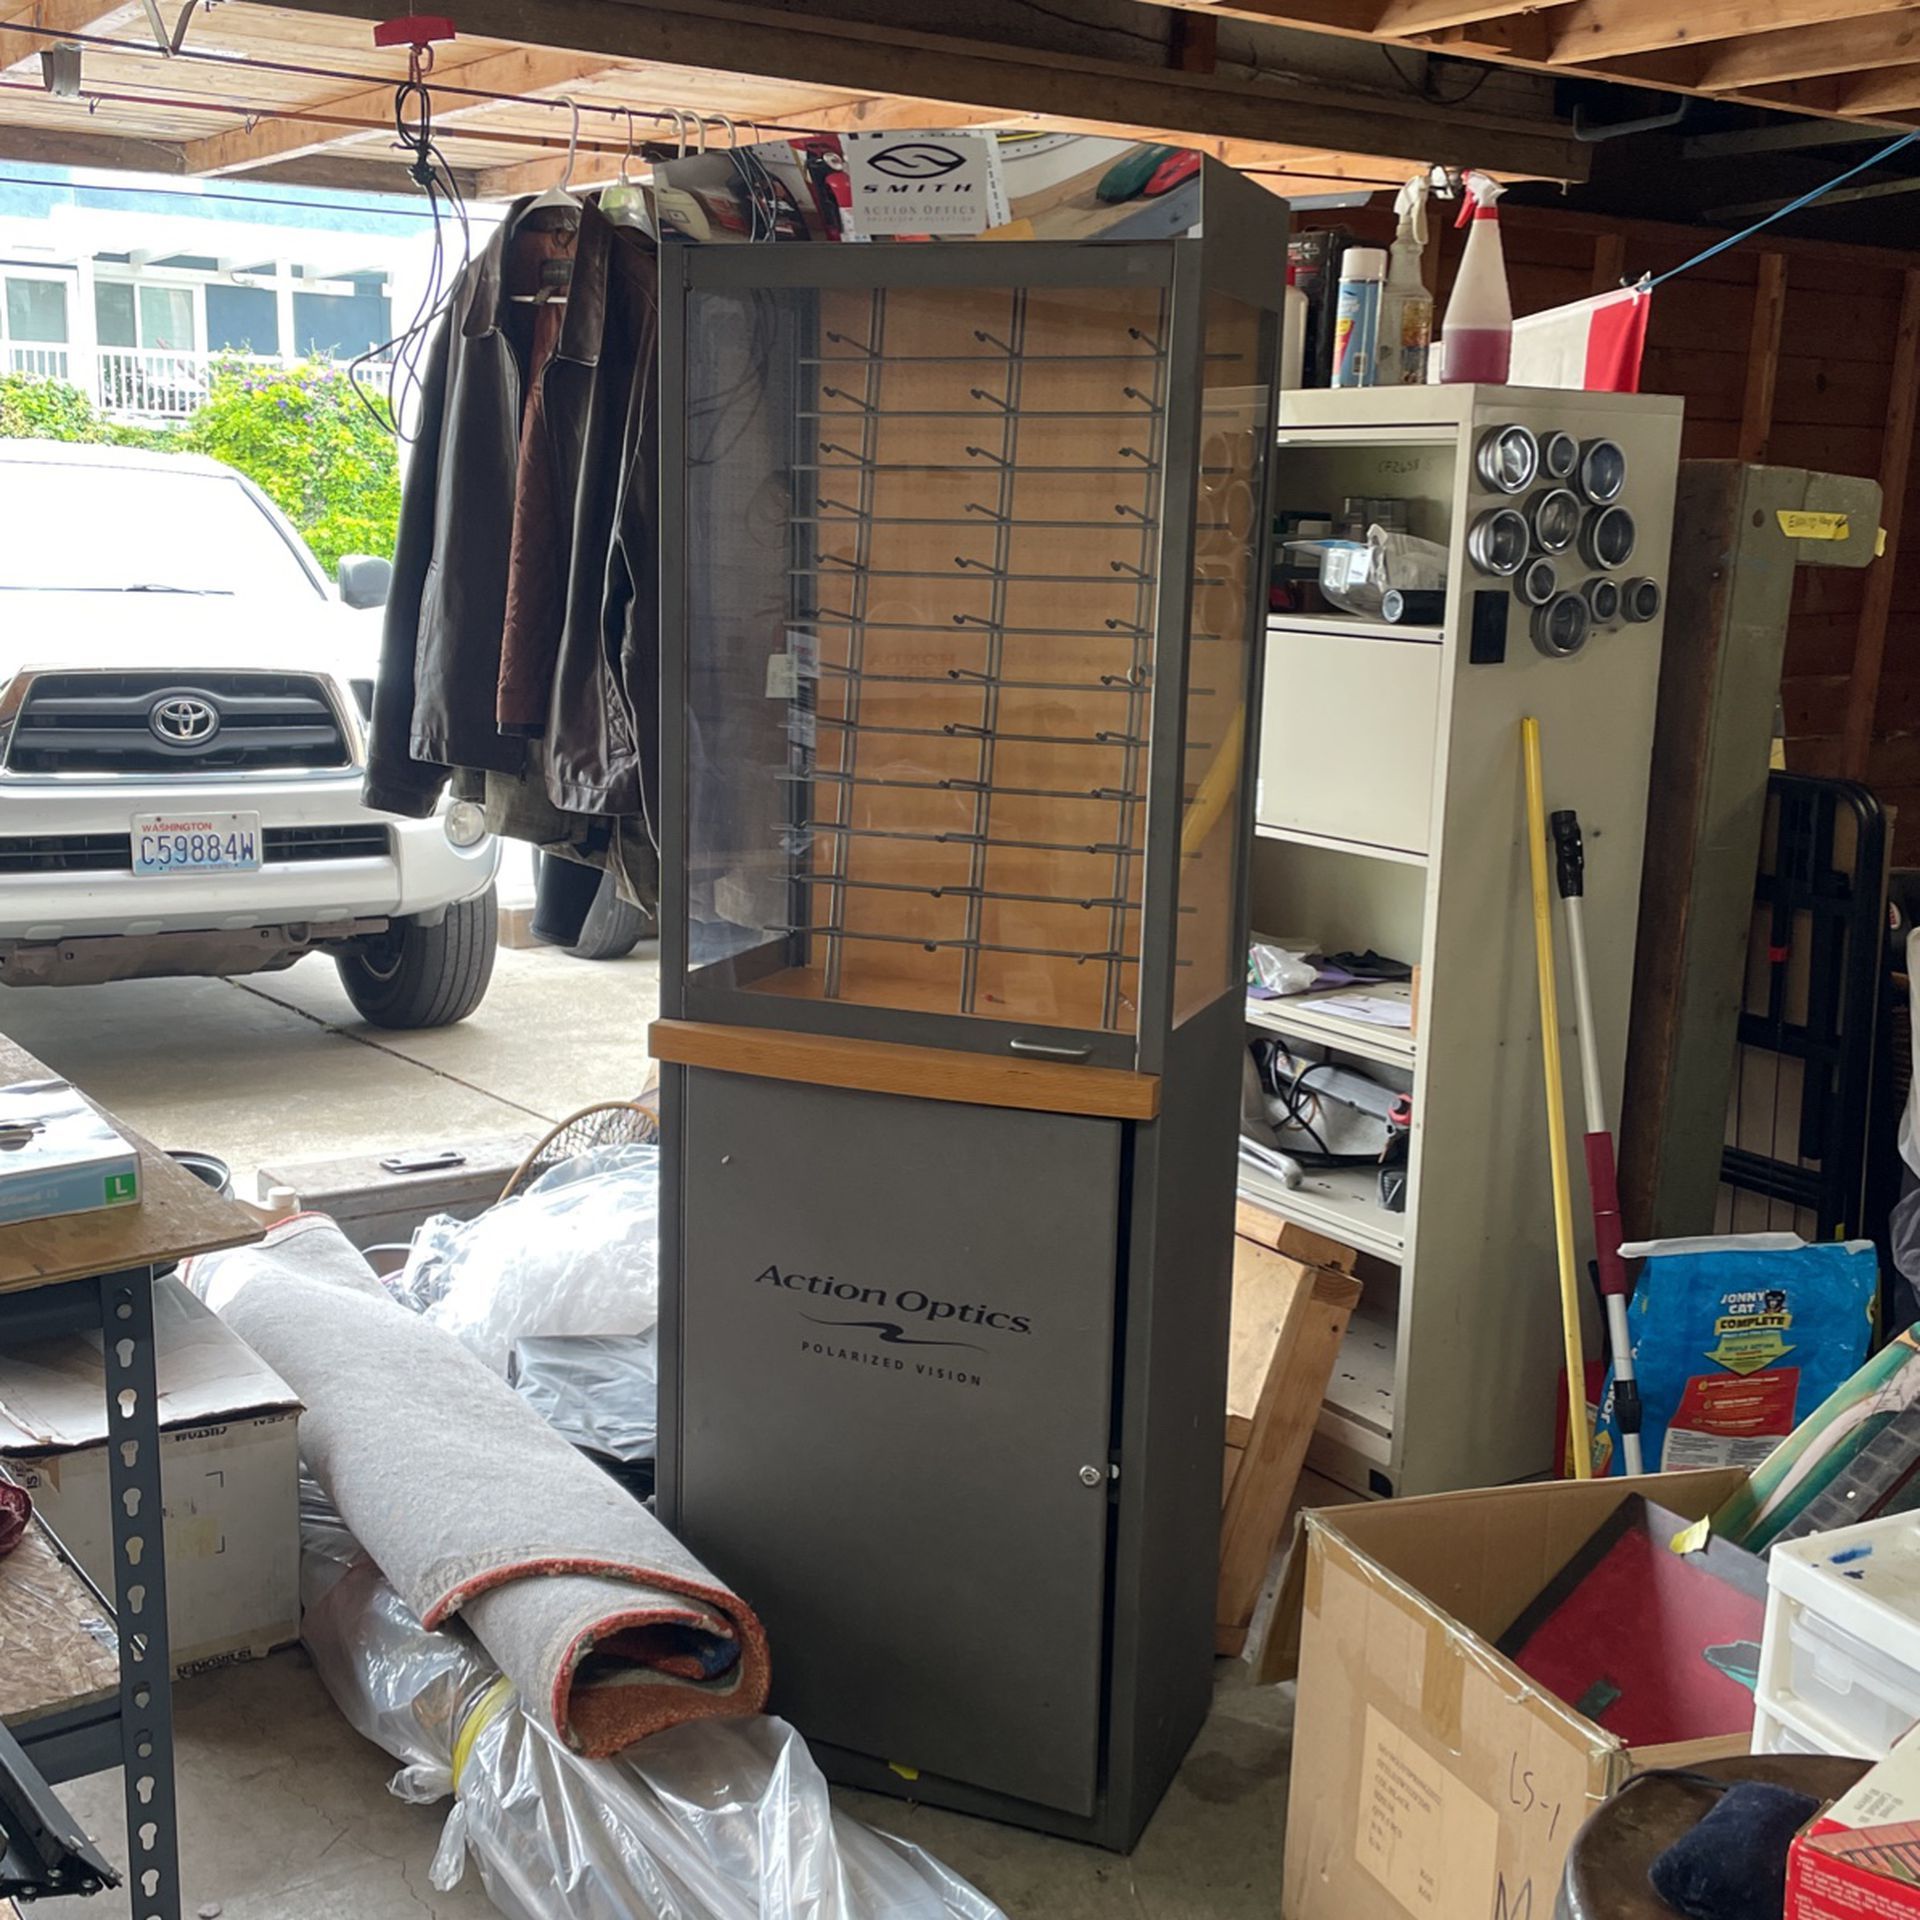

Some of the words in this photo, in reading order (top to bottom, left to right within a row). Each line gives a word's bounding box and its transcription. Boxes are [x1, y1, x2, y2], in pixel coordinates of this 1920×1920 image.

[863, 184, 973, 194] SMITH
[864, 206, 917, 215] ACTION
[923, 205, 976, 215] OPTICS
[141, 822, 213, 832] WASHINGTON
[141, 832, 254, 865] C59884W
[115, 1177, 128, 1195] L
[755, 1265, 887, 1306] Action
[895, 1290, 1031, 1334] Optics
[1720, 1291, 1766, 1304] JONNY
[1728, 1304, 1755, 1314] CAT
[1720, 1317, 1785, 1329] COMPLETE
[802, 1341, 905, 1370] POLARIZED
[916, 1364, 982, 1387] VISION
